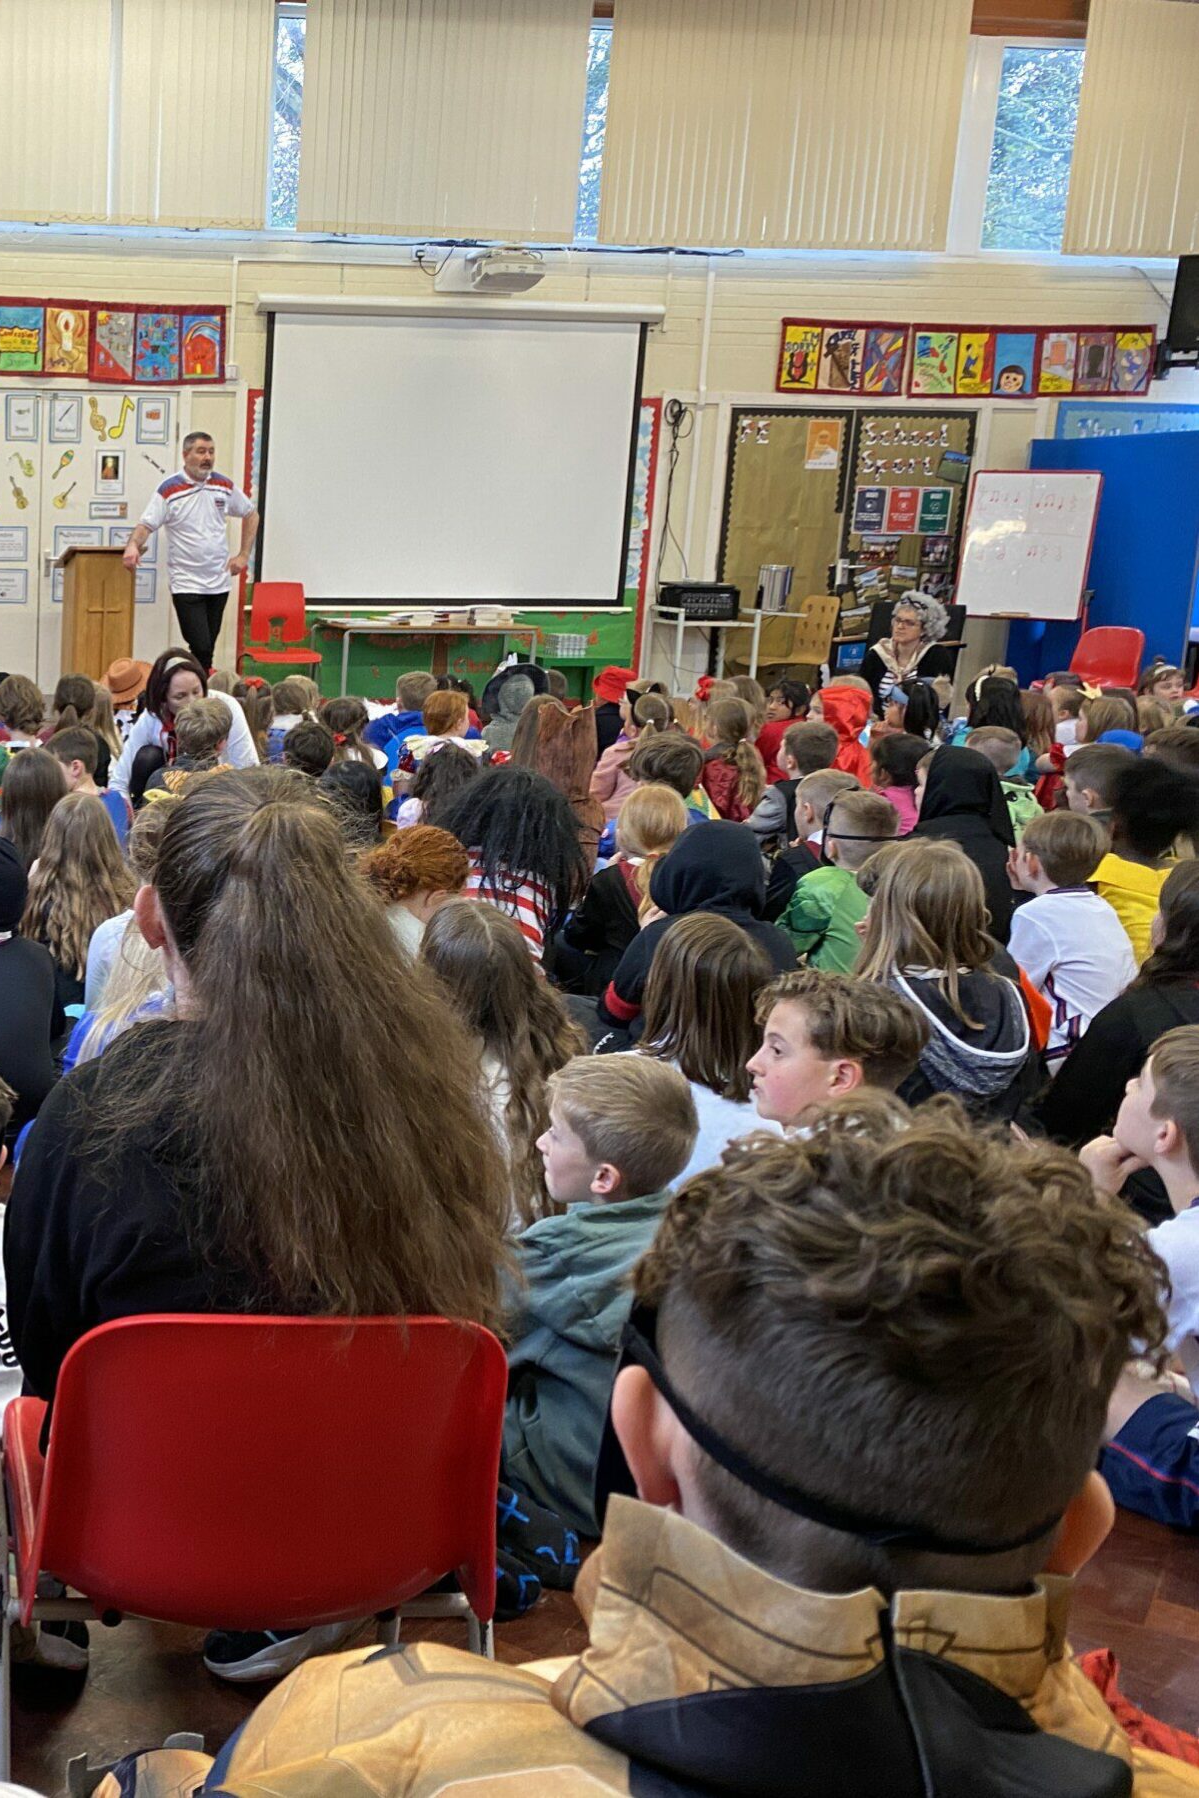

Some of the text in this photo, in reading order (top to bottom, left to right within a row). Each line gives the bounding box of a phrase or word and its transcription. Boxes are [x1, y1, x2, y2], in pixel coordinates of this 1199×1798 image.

[740, 419, 771, 444] PE
[864, 421, 950, 447] School
[861, 449, 934, 482] Sport
